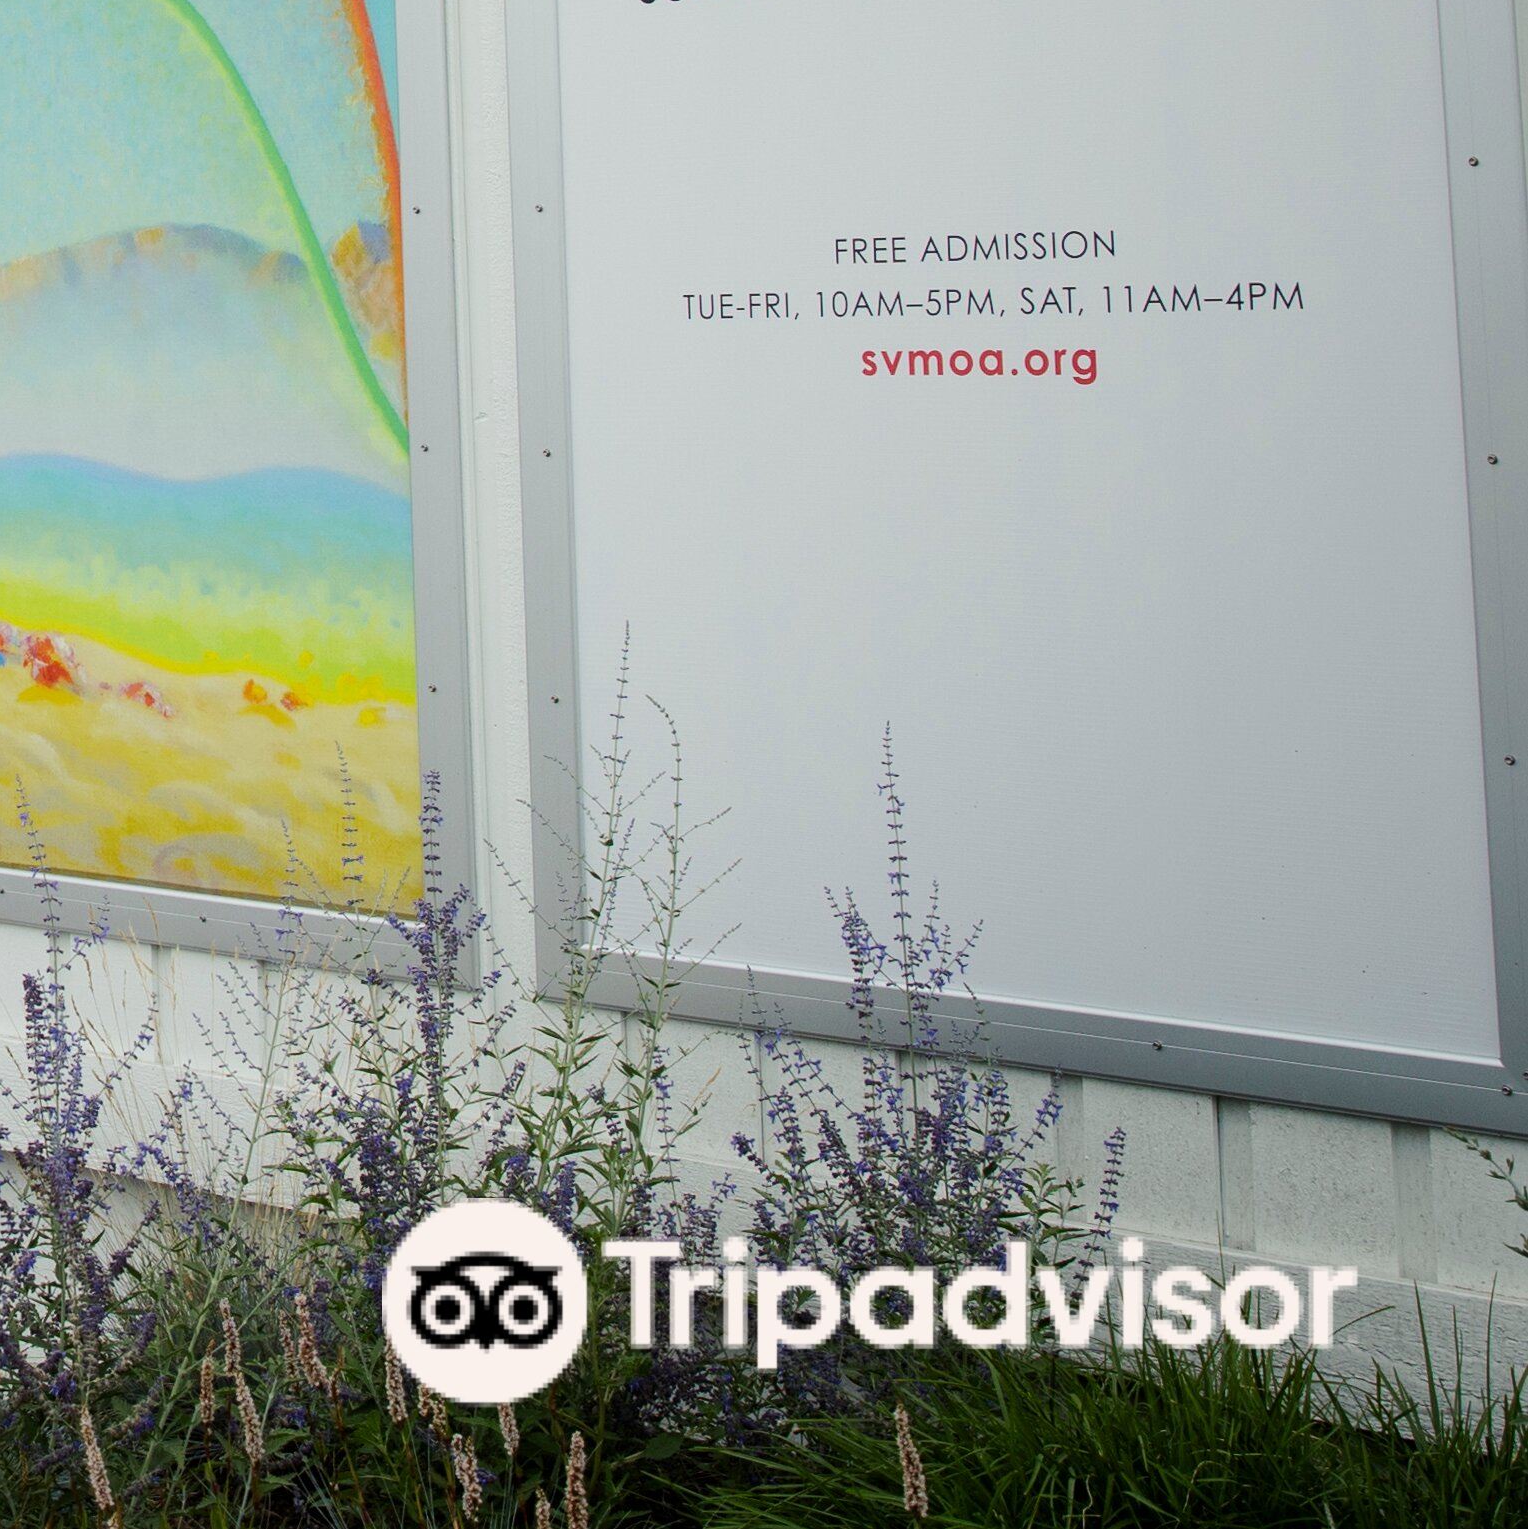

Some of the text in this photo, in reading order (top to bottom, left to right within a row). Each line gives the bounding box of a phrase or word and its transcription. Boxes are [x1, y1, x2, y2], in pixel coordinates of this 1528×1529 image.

[835, 229, 1117, 265] FREE ADMISSION
[682, 291, 800, 321] TUE-FRI,
[1020, 286, 1084, 317] SAT,
[860, 345, 1099, 385] svmoa.org
